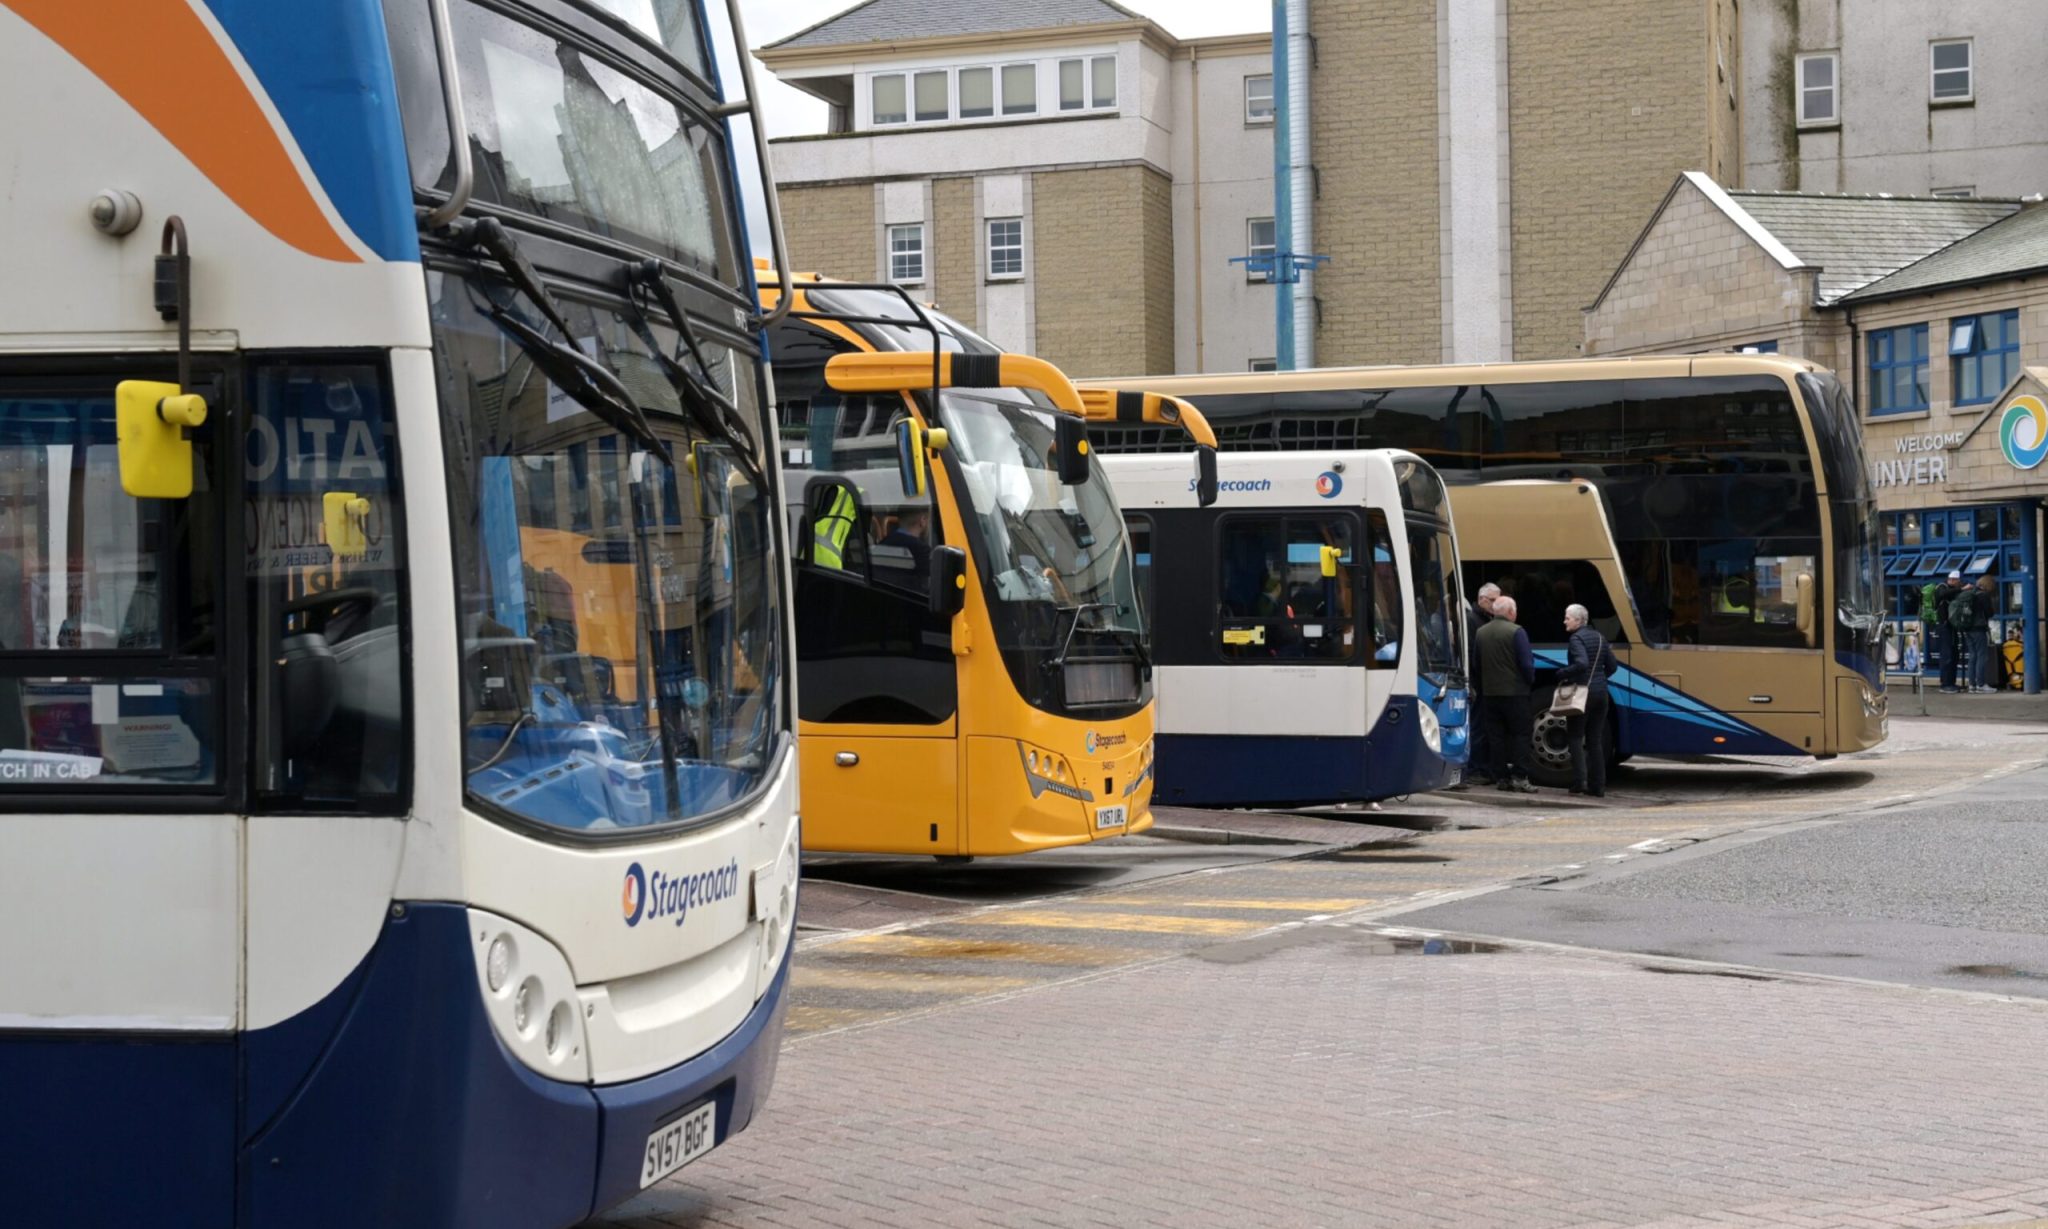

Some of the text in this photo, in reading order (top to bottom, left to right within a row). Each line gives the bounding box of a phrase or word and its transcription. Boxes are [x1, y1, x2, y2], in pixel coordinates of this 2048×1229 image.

[1895, 431, 1964, 453] WELCOME
[1875, 456, 1949, 487] INVER
[1188, 479, 1271, 492] Secoach
[1095, 731, 1126, 750] Stagecoach
[33, 763, 50, 778] IN
[647, 856, 738, 927] Stagecoach
[647, 1110, 709, 1178] SV57 BGF
